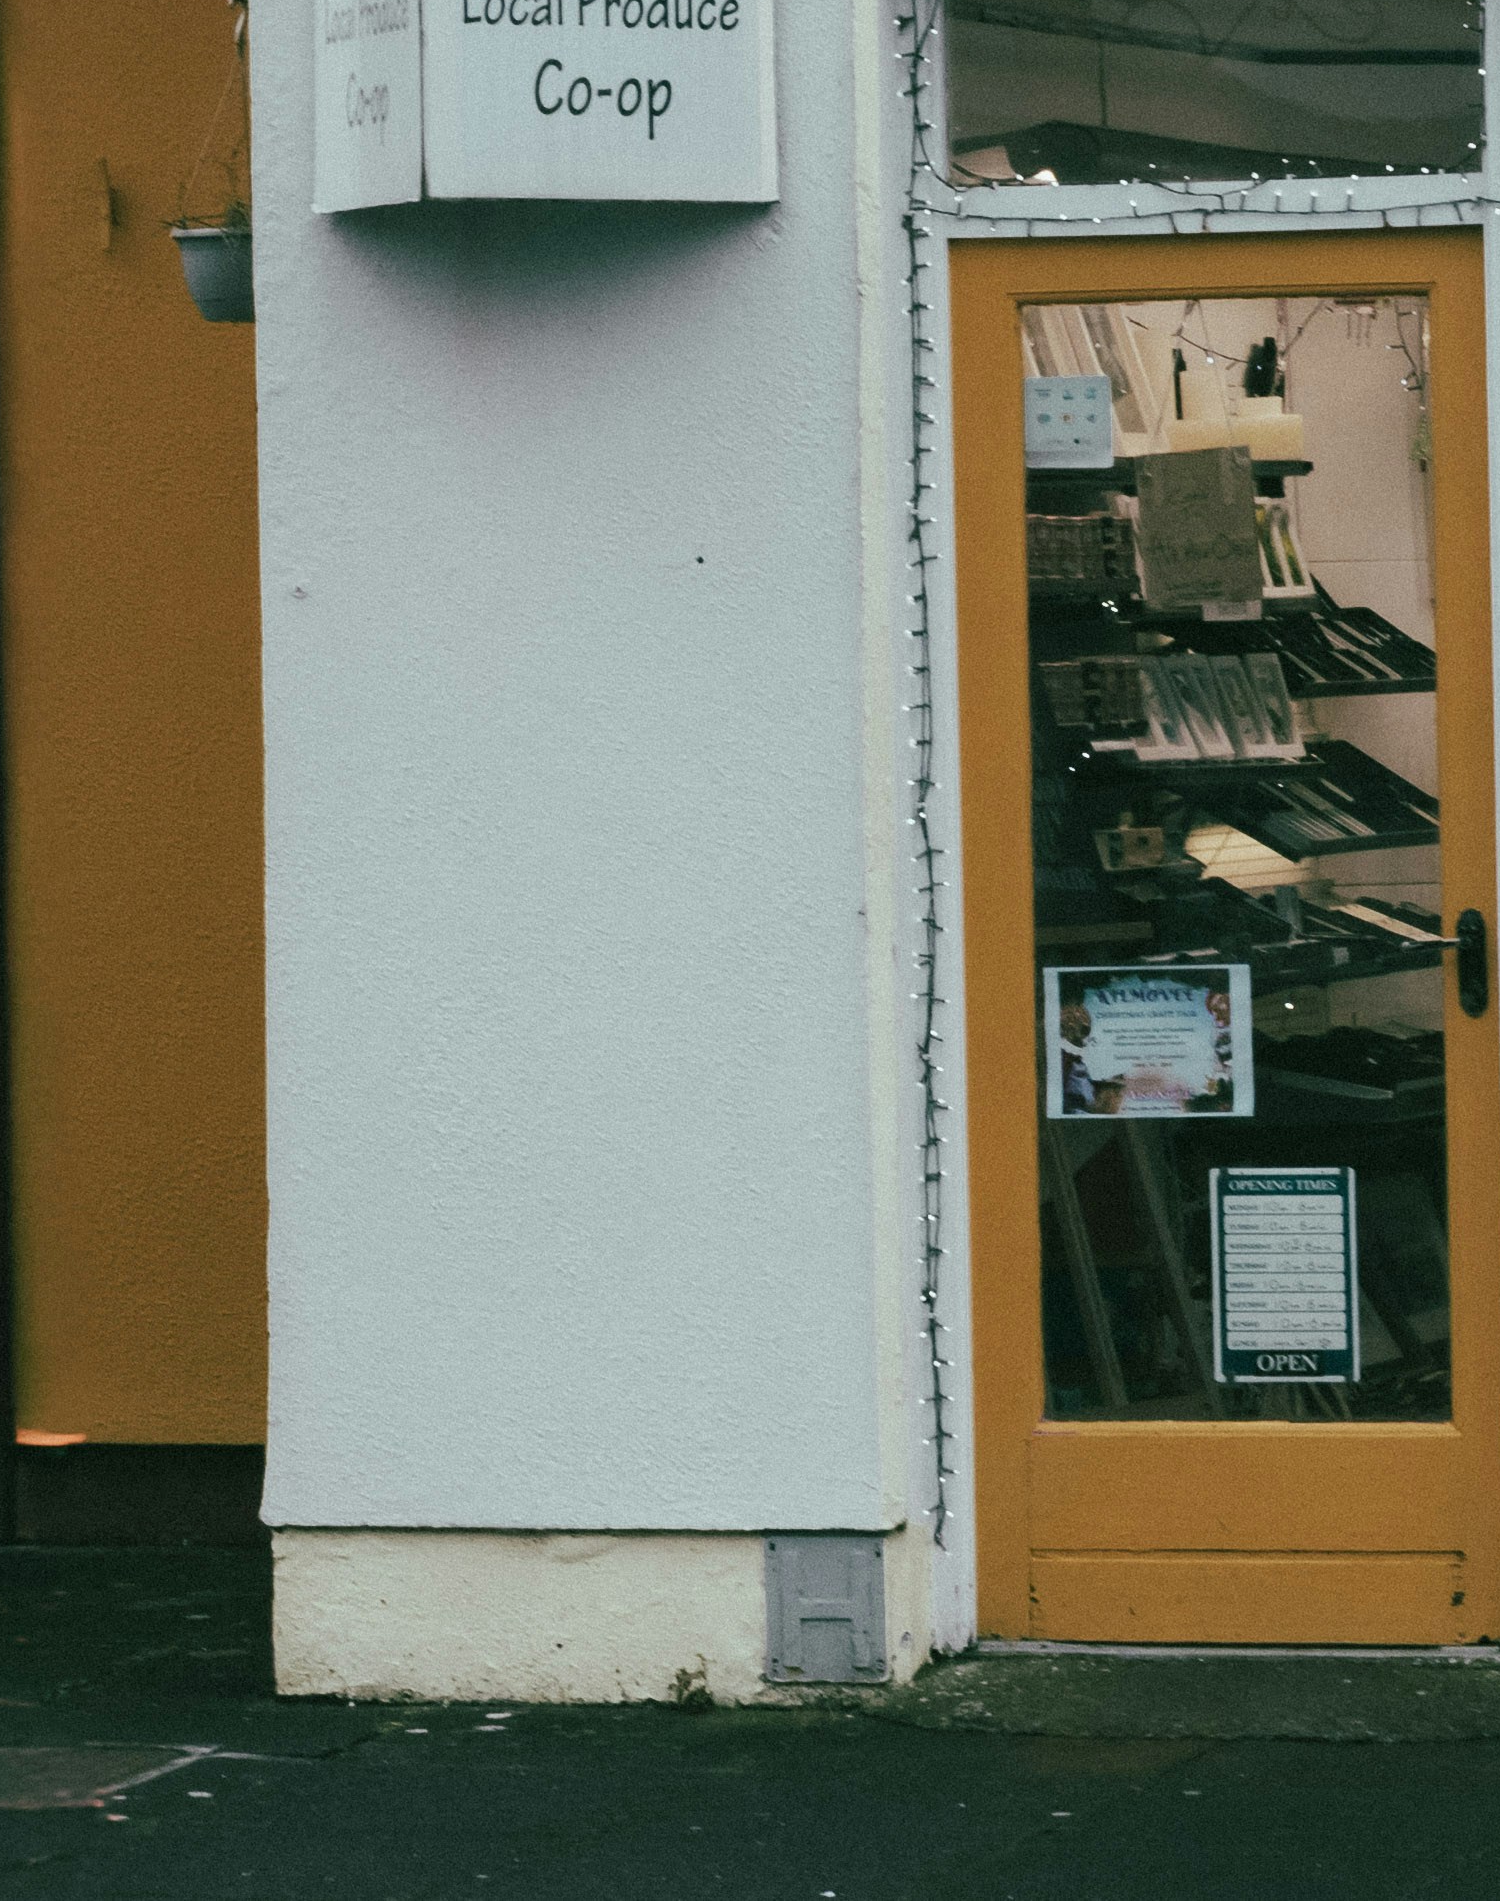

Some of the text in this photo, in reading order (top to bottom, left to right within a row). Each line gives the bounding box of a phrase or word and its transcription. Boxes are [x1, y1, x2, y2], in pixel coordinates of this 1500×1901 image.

[535, 59, 672, 140] Co-op
[1228, 1179, 1337, 1191] OPENING TIMES
[1256, 1354, 1318, 1371] OPEN
